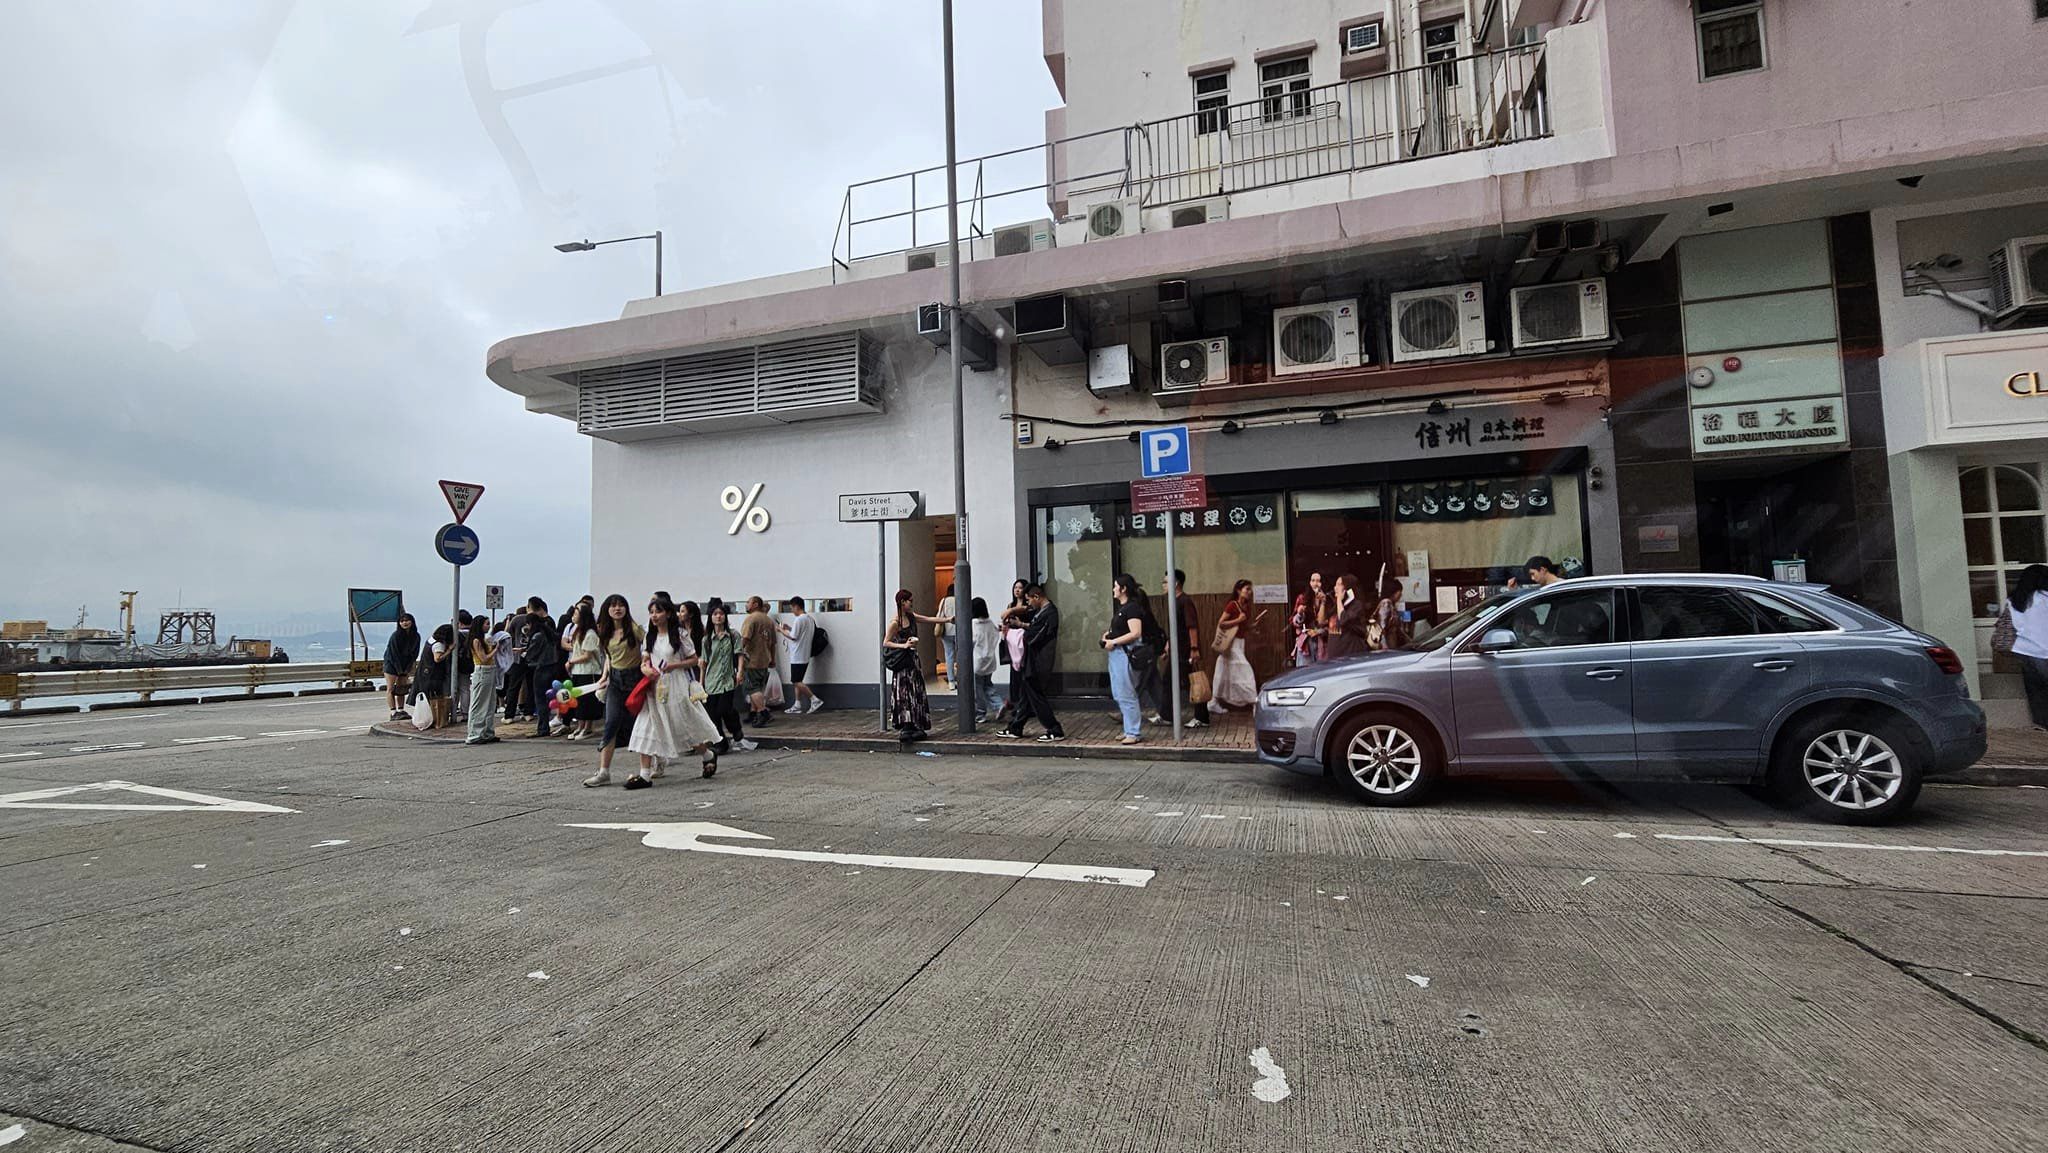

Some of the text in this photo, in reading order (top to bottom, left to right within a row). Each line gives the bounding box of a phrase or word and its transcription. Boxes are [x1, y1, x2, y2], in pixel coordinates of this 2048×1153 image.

[1415, 417, 1544, 449] 信州 日本料理
[1703, 427, 1837, 445] GRAND FORTUNE MANSION
[1149, 433, 1180, 473] P
[721, 483, 771, 535] %
